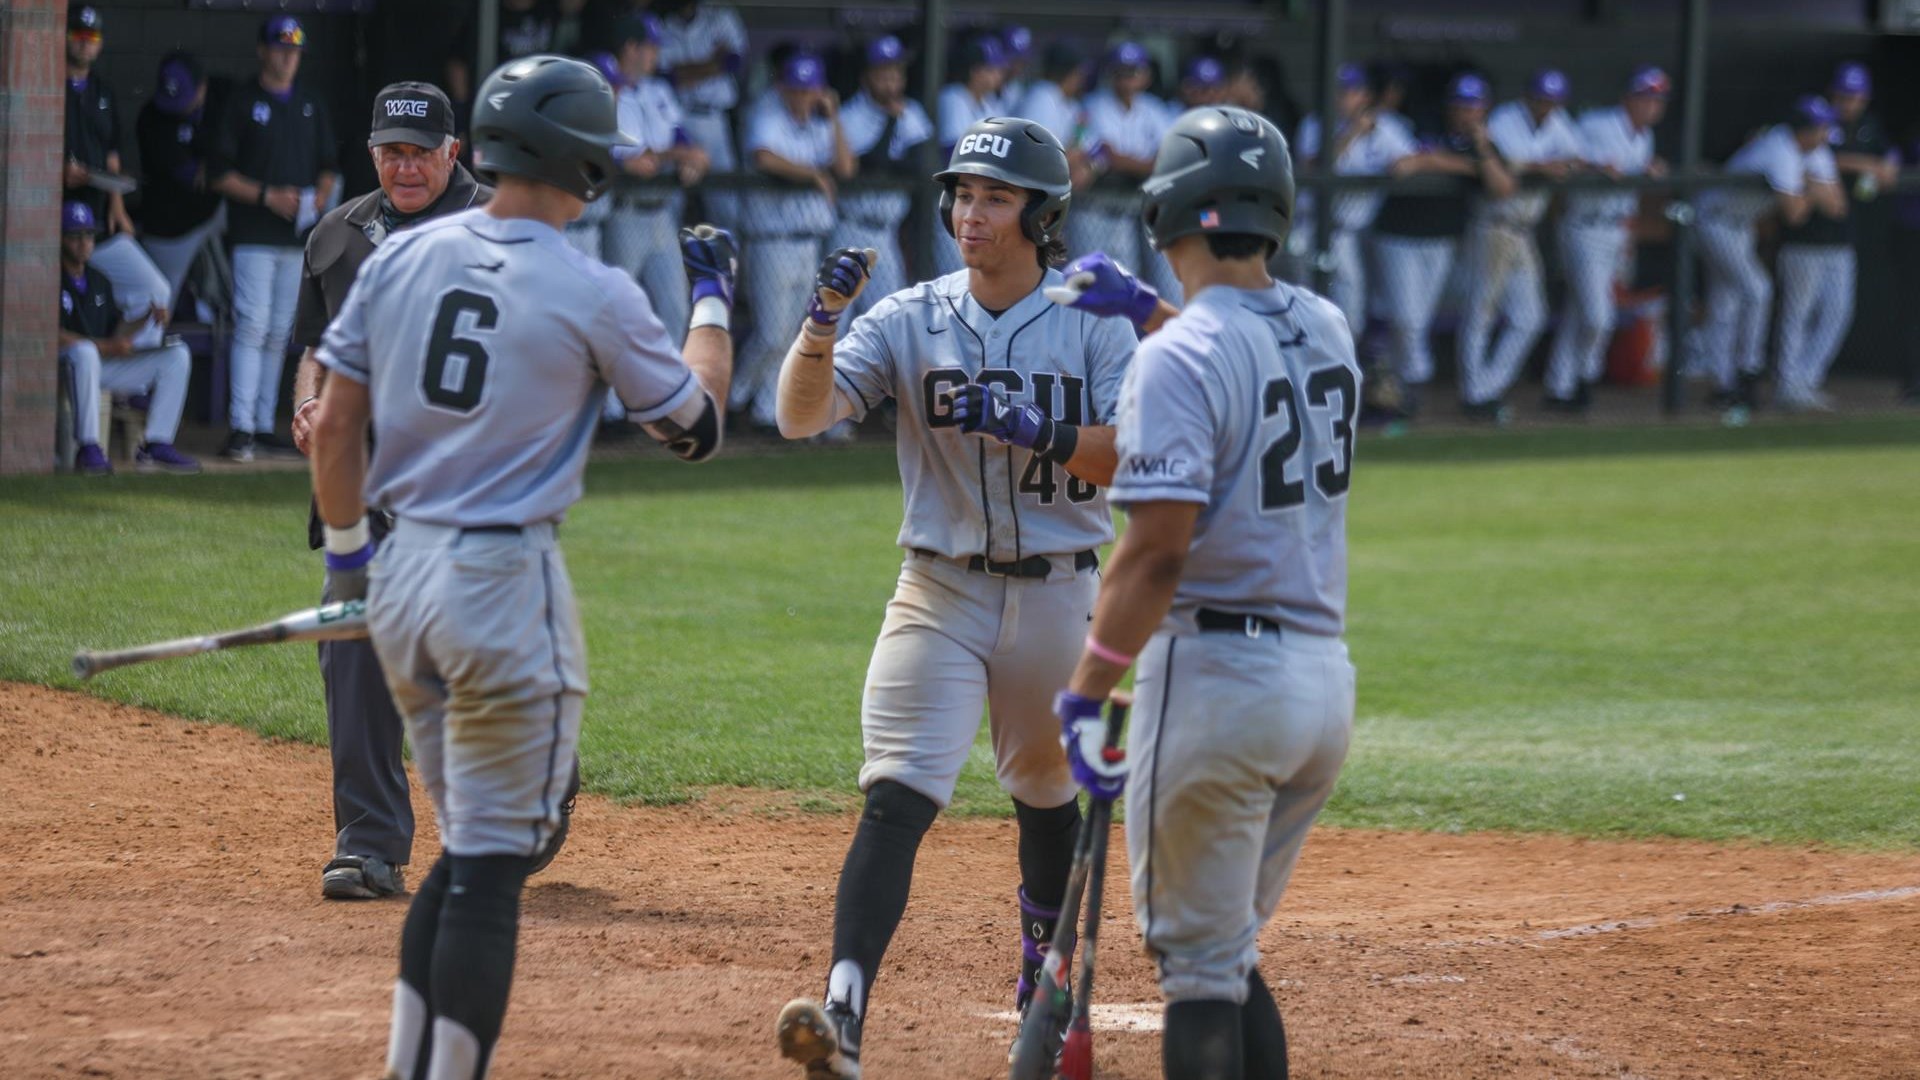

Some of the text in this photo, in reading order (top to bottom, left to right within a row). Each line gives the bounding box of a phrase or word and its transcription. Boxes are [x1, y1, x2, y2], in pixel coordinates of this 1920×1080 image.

[385, 100, 429, 117] WAC
[959, 133, 1013, 159] GCU
[416, 285, 504, 418] 6
[1258, 362, 1358, 515] 23
[1127, 456, 1188, 477] WAC
